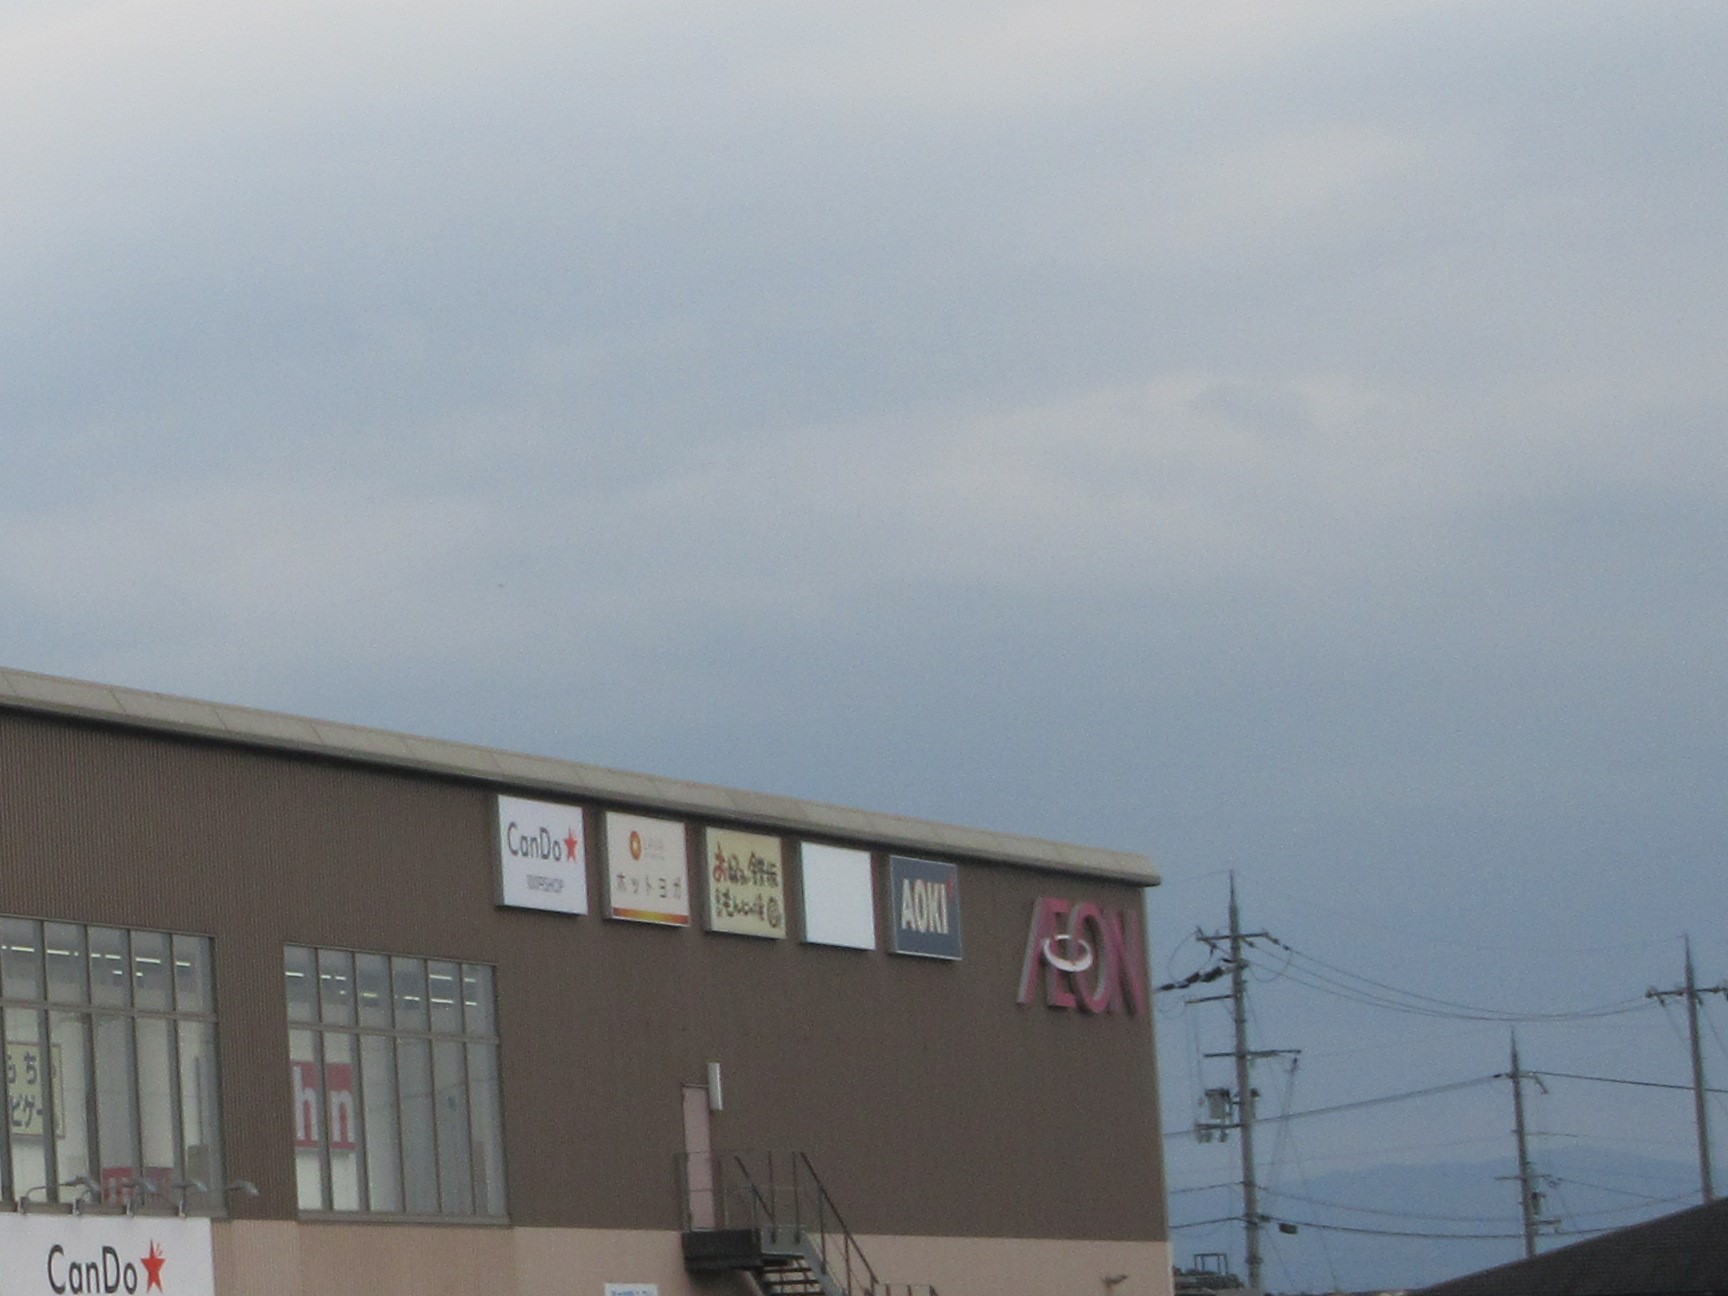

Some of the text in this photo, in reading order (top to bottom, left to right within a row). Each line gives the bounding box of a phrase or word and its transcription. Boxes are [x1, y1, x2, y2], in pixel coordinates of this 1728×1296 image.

[507, 821, 562, 862] CanDo
[616, 872, 682, 901] ホットヨガ
[900, 878, 949, 934] AOKI
[46, 1242, 139, 1296] CanDo
